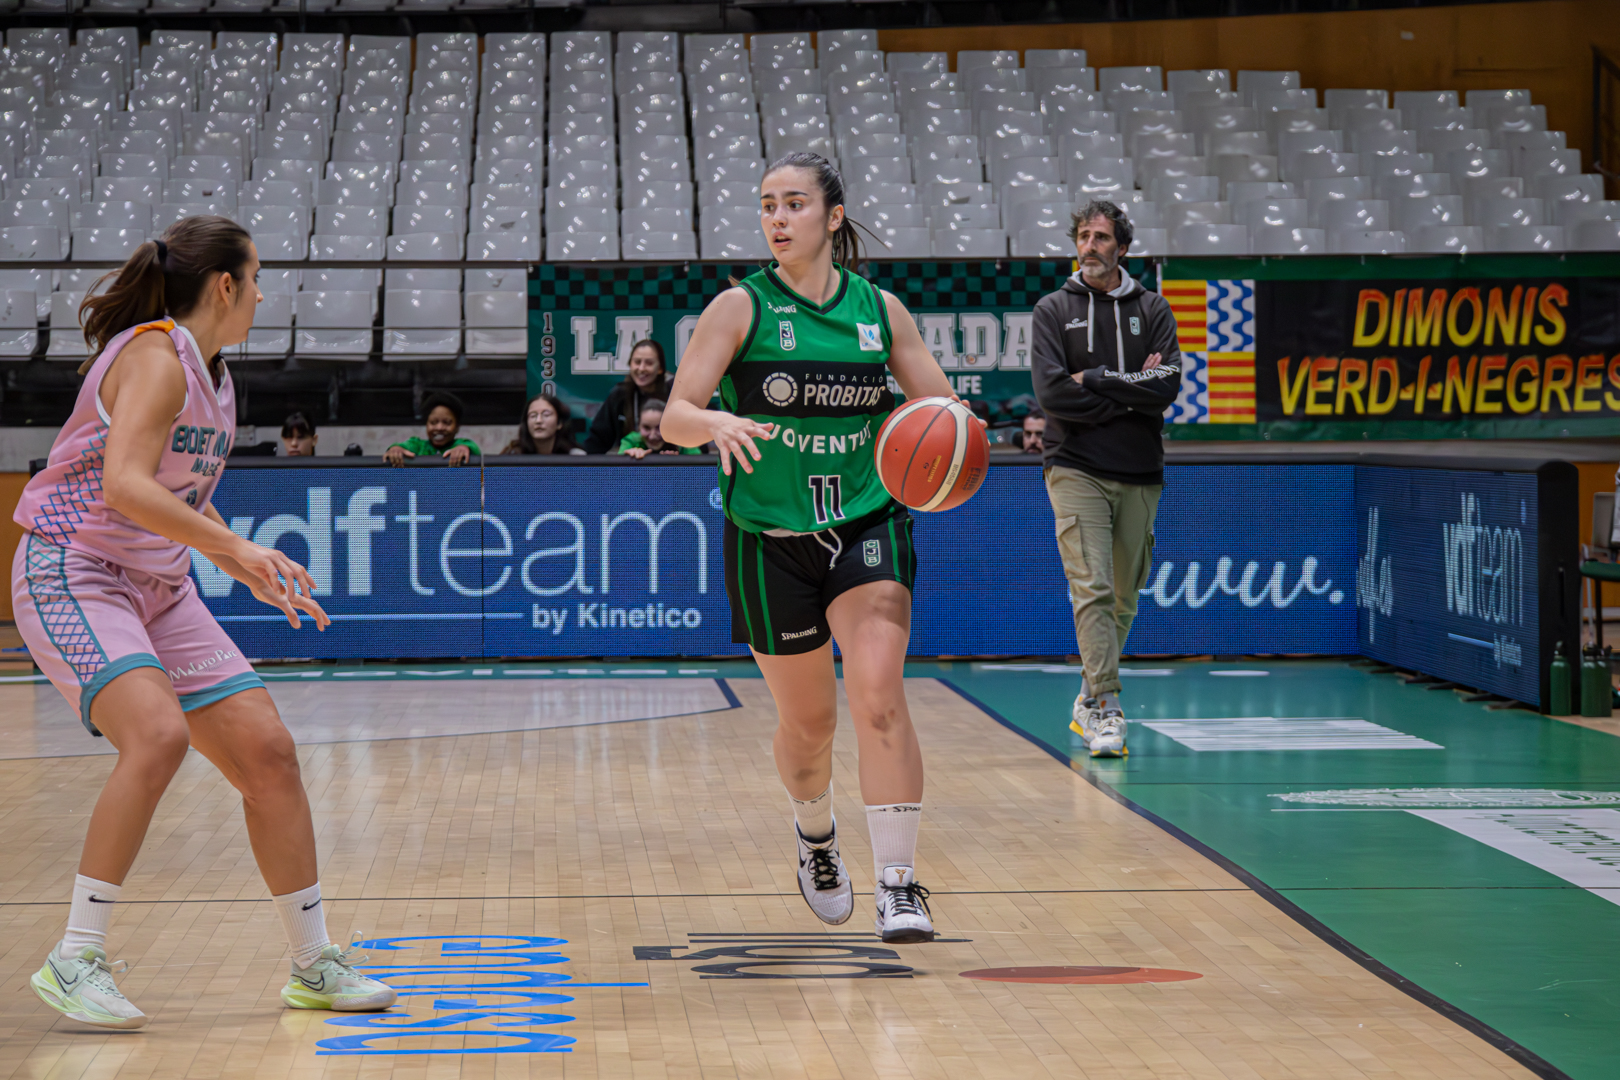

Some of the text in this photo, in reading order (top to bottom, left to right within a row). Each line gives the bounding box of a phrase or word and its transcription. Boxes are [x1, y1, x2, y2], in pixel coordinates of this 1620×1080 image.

[1353, 283, 1569, 347] DIMONIS
[805, 373, 884, 384] FUNDACIÓ
[803, 383, 886, 407] PROBITAS
[808, 474, 846, 524] 11
[532, 602, 702, 635] by Kinetico
[781, 625, 818, 641] SPALDING
